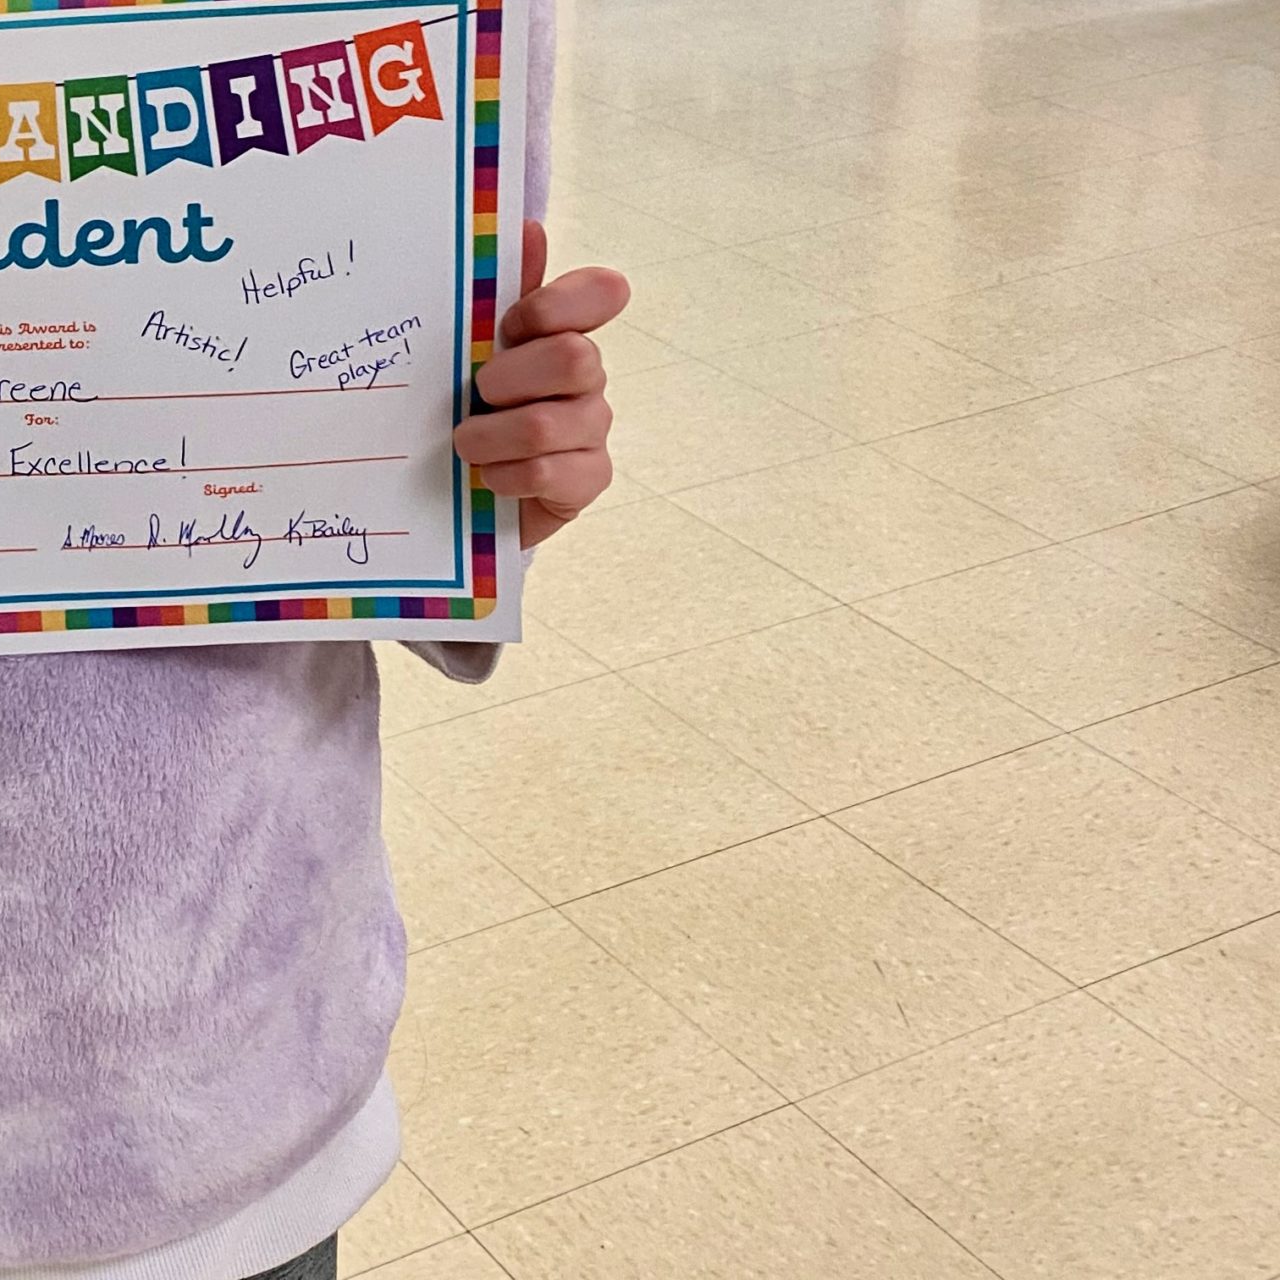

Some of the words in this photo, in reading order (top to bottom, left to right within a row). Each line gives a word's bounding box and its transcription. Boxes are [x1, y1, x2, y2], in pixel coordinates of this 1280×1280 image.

[18, 321, 79, 336] Award
[83, 320, 97, 333] is
[141, 310, 248, 372] Artistic!
[69, 338, 90, 350] to:
[289, 341, 355, 379] Great
[358, 315, 421, 347] team
[337, 338, 411, 391] player!
[24, 413, 59, 427] For:
[10, 435, 188, 480] Excellence!
[203, 482, 263, 498] Signed:
